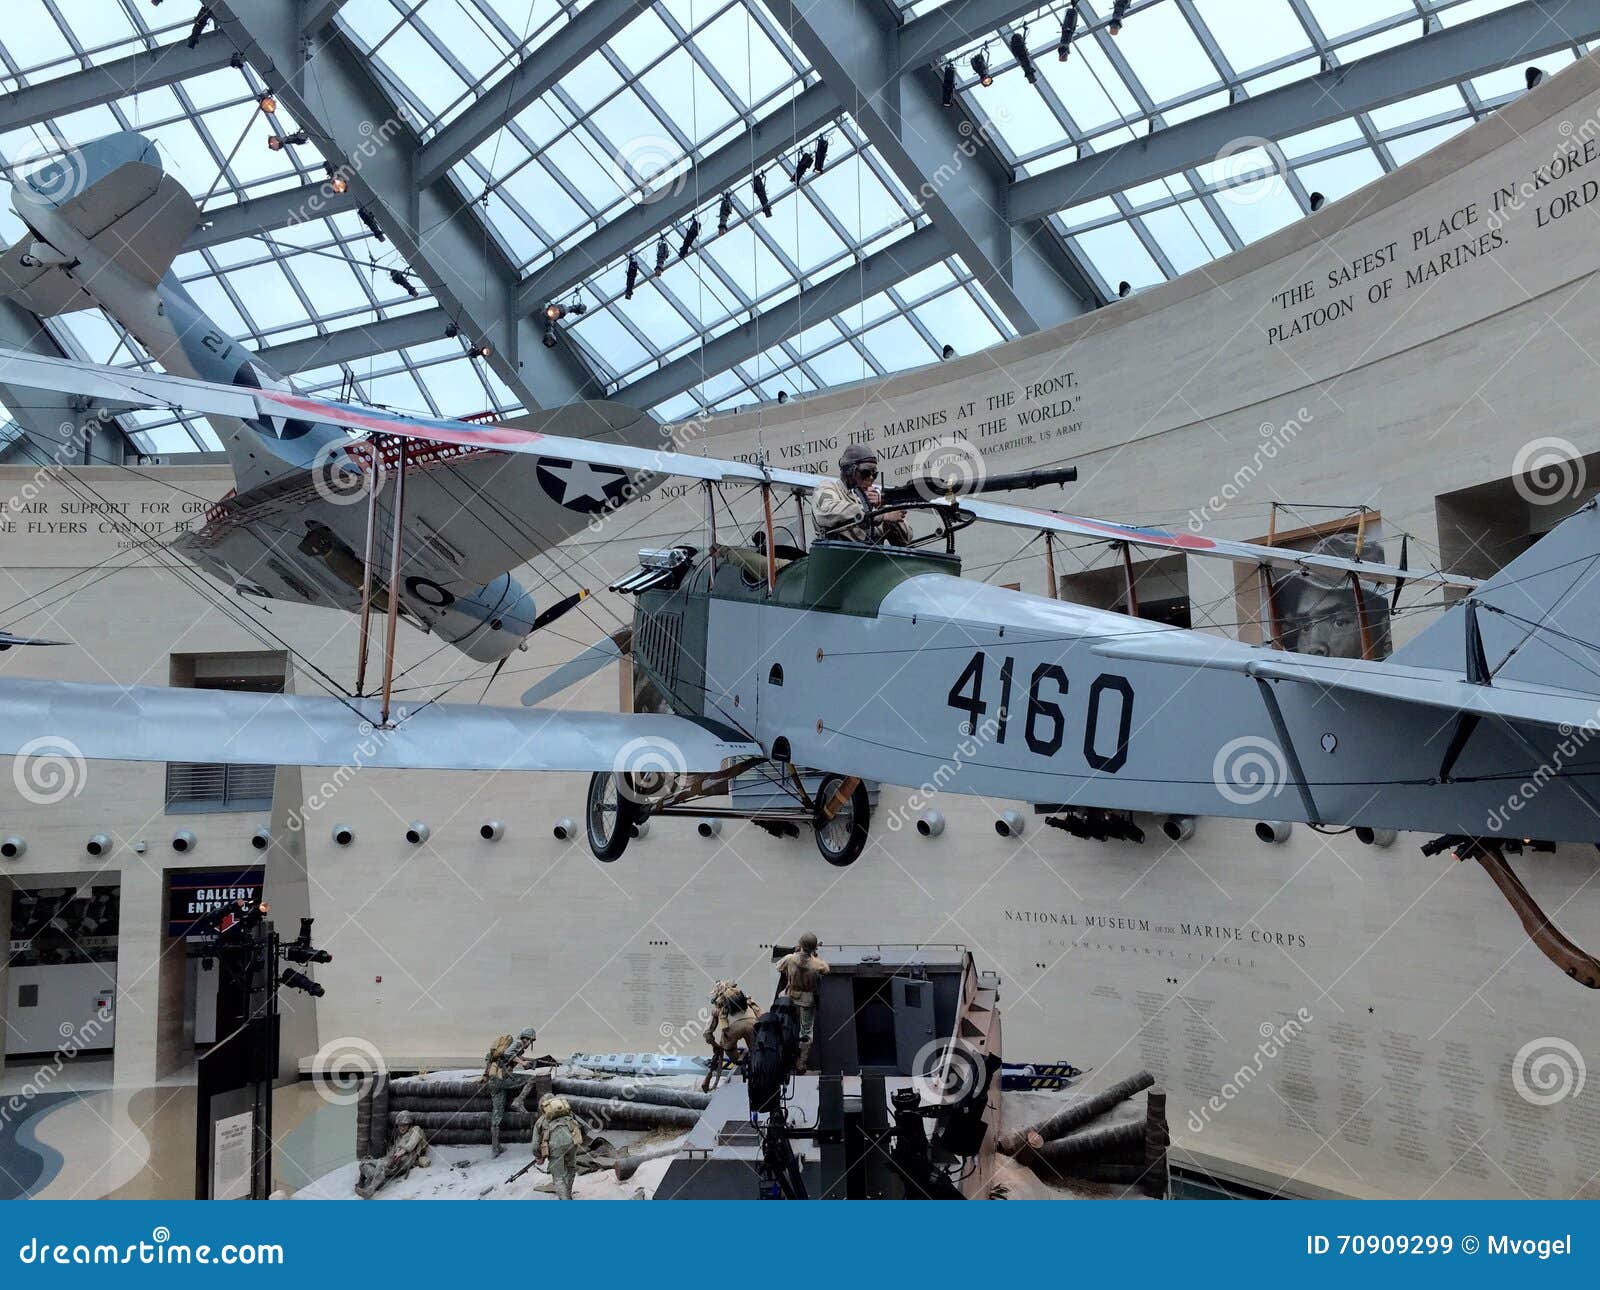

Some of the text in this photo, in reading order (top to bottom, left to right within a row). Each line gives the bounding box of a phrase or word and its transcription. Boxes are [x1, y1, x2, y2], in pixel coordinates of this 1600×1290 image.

[1272, 139, 1600, 310] "THE SAFEST PLACE IN KORE
[1268, 180, 1599, 345] PLATOON OF MARINES. LORD
[847, 428, 875, 445] THE
[884, 410, 947, 438] MARINES
[957, 402, 976, 419] AT
[986, 391, 1015, 411] THE
[1025, 372, 1079, 400] FRONT,
[1039, 429, 1051, 442] US
[1055, 421, 1083, 438] ARMY
[661, 485, 688, 500] NOT
[953, 427, 968, 445] IN
[978, 418, 1007, 438] THE
[1017, 396, 1081, 427] WORLD."
[20, 503, 48, 514] AIR
[60, 503, 130, 514] SUPPORT
[141, 503, 170, 514] FOR
[28, 522, 88, 533] FLYERS
[948, 651, 1135, 774] 4160
[196, 888, 254, 900] GALLERY
[1004, 910, 1078, 926] NATIONAL
[1085, 915, 1150, 932] MUSEUM
[1180, 922, 1242, 942] MARINE
[1251, 930, 1306, 949] CORPS
